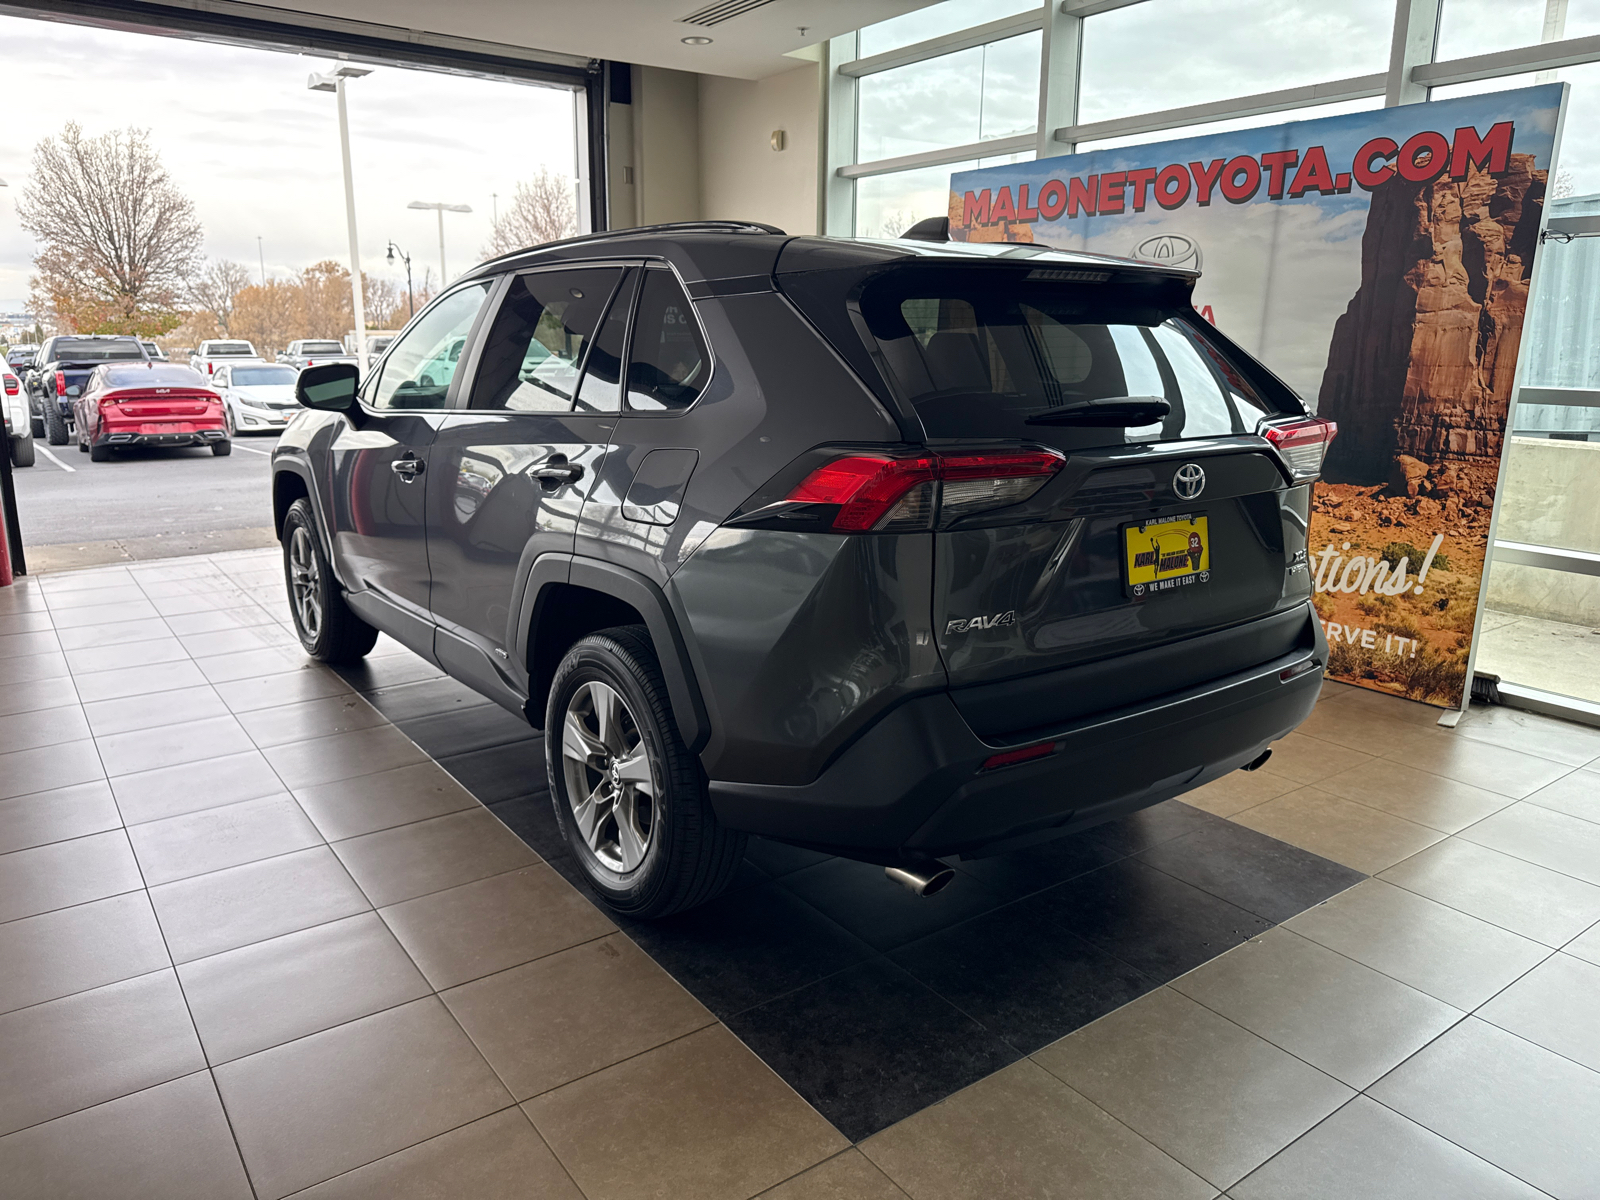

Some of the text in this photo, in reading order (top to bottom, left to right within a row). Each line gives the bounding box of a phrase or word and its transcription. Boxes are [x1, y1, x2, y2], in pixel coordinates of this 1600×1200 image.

[963, 120, 1515, 228] MALONETOYOTA.COM
[1145, 513, 1192, 526] KARL MALONE TOYOTA
[1190, 537, 1199, 548] 32
[1134, 551, 1155, 568] KARL
[1159, 554, 1189, 572] MALONE
[1309, 534, 1444, 596] tions!
[1149, 575, 1196, 592] WE MAKE IT EASY
[945, 610, 1016, 635] RAV4
[1385, 634, 1418, 659] IT!
